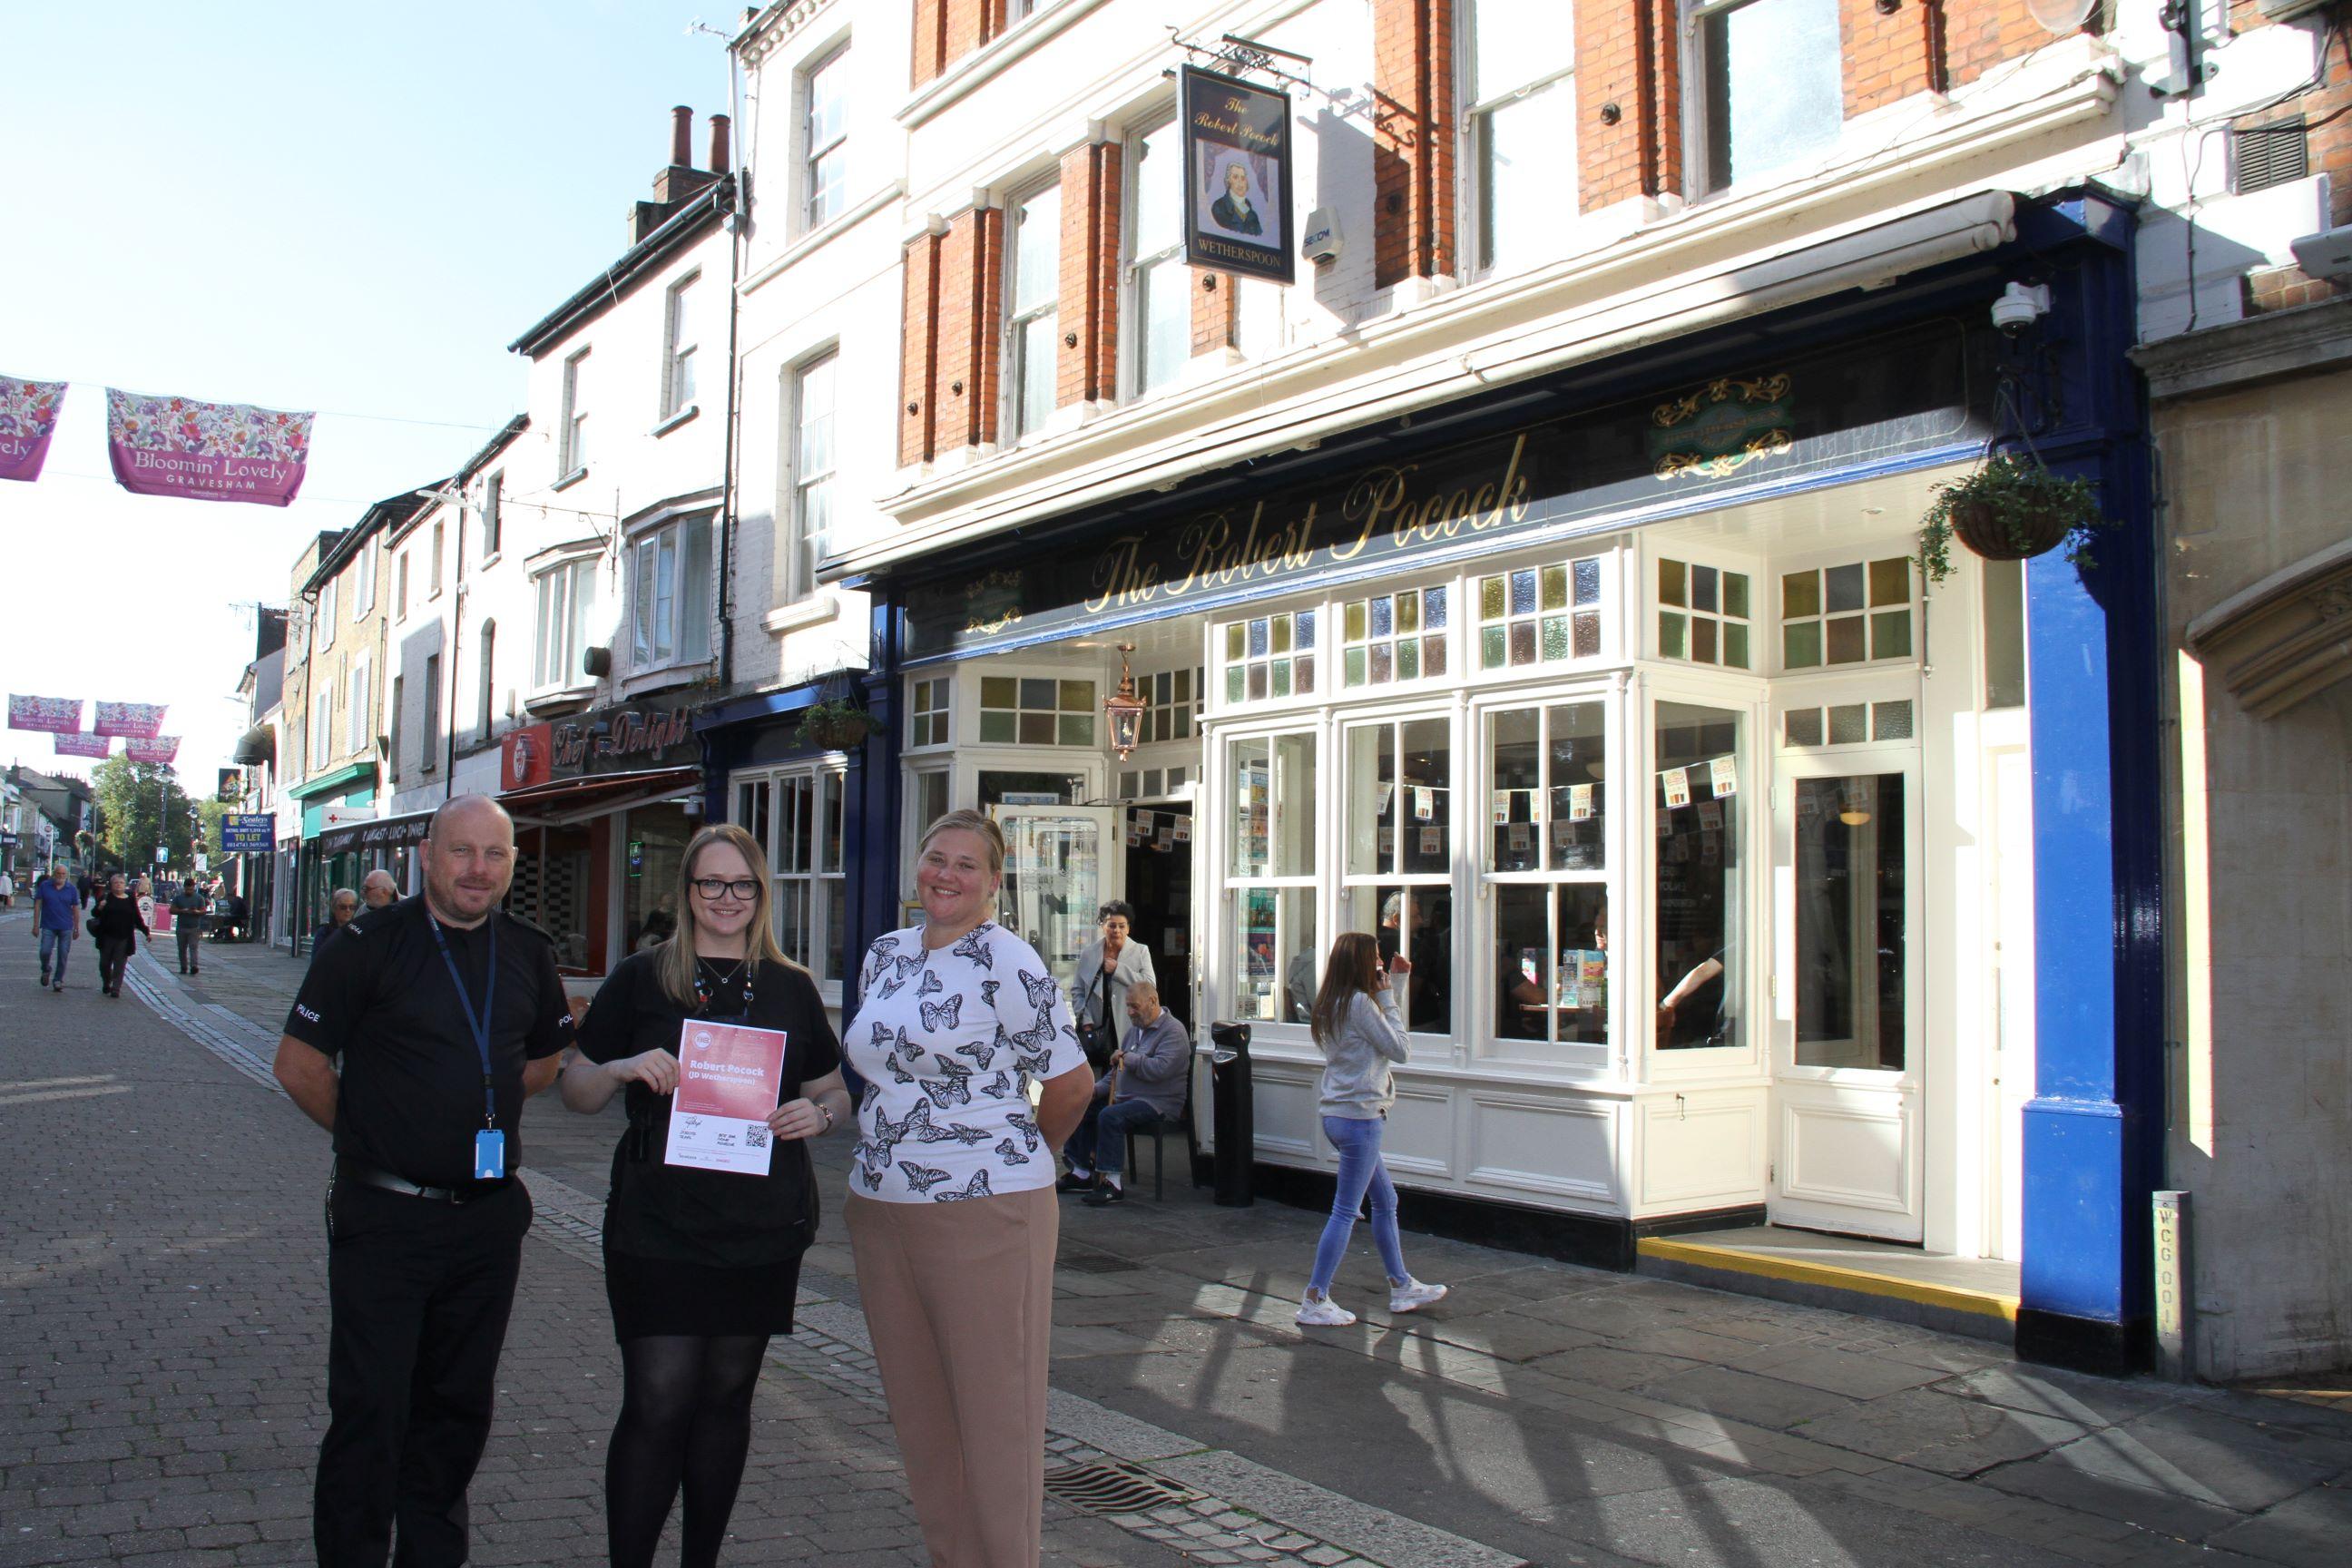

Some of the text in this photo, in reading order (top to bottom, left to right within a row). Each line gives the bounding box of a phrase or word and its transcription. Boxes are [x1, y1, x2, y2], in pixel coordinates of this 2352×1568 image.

[1225, 96, 1249, 114] The
[1194, 111, 1278, 146] Robert Pocock
[1198, 239, 1281, 268] WETHERSPOON
[0, 440, 31, 460] ely
[134, 451, 287, 485] Bloomin' Lovely
[166, 474, 255, 490] GRAVESHAM
[1084, 433, 1532, 613] The Robert Pocock
[610, 704, 691, 761] Delight
[235, 833, 261, 842] TO LET
[296, 1004, 320, 1023] POLICE
[558, 1014, 573, 1027] POL
[690, 1060, 765, 1077] Robert Pocock
